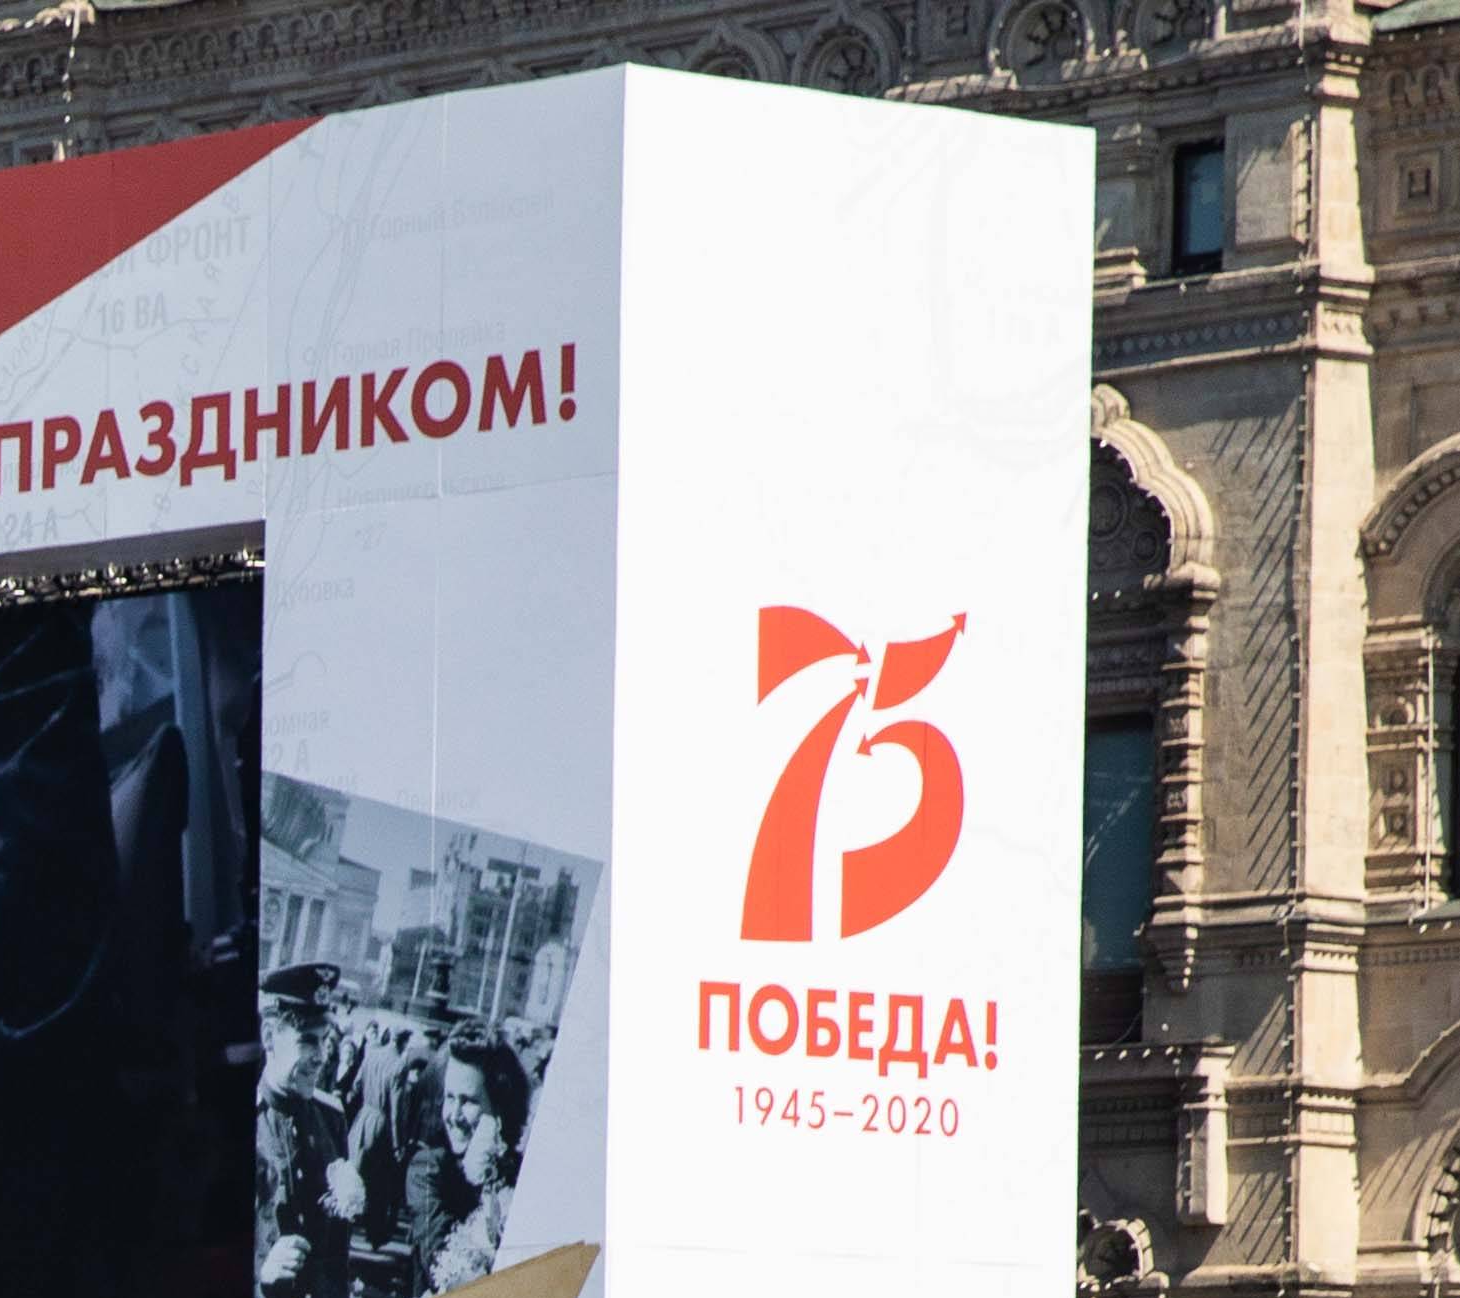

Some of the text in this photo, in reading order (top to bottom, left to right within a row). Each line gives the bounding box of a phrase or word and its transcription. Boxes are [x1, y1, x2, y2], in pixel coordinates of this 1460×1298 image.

[145, 215, 251, 268] ФРОНТ
[96, 290, 169, 336] 16 ВА
[740, 605, 968, 943] 75
[697, 979, 998, 1080] ПОБЕДА!
